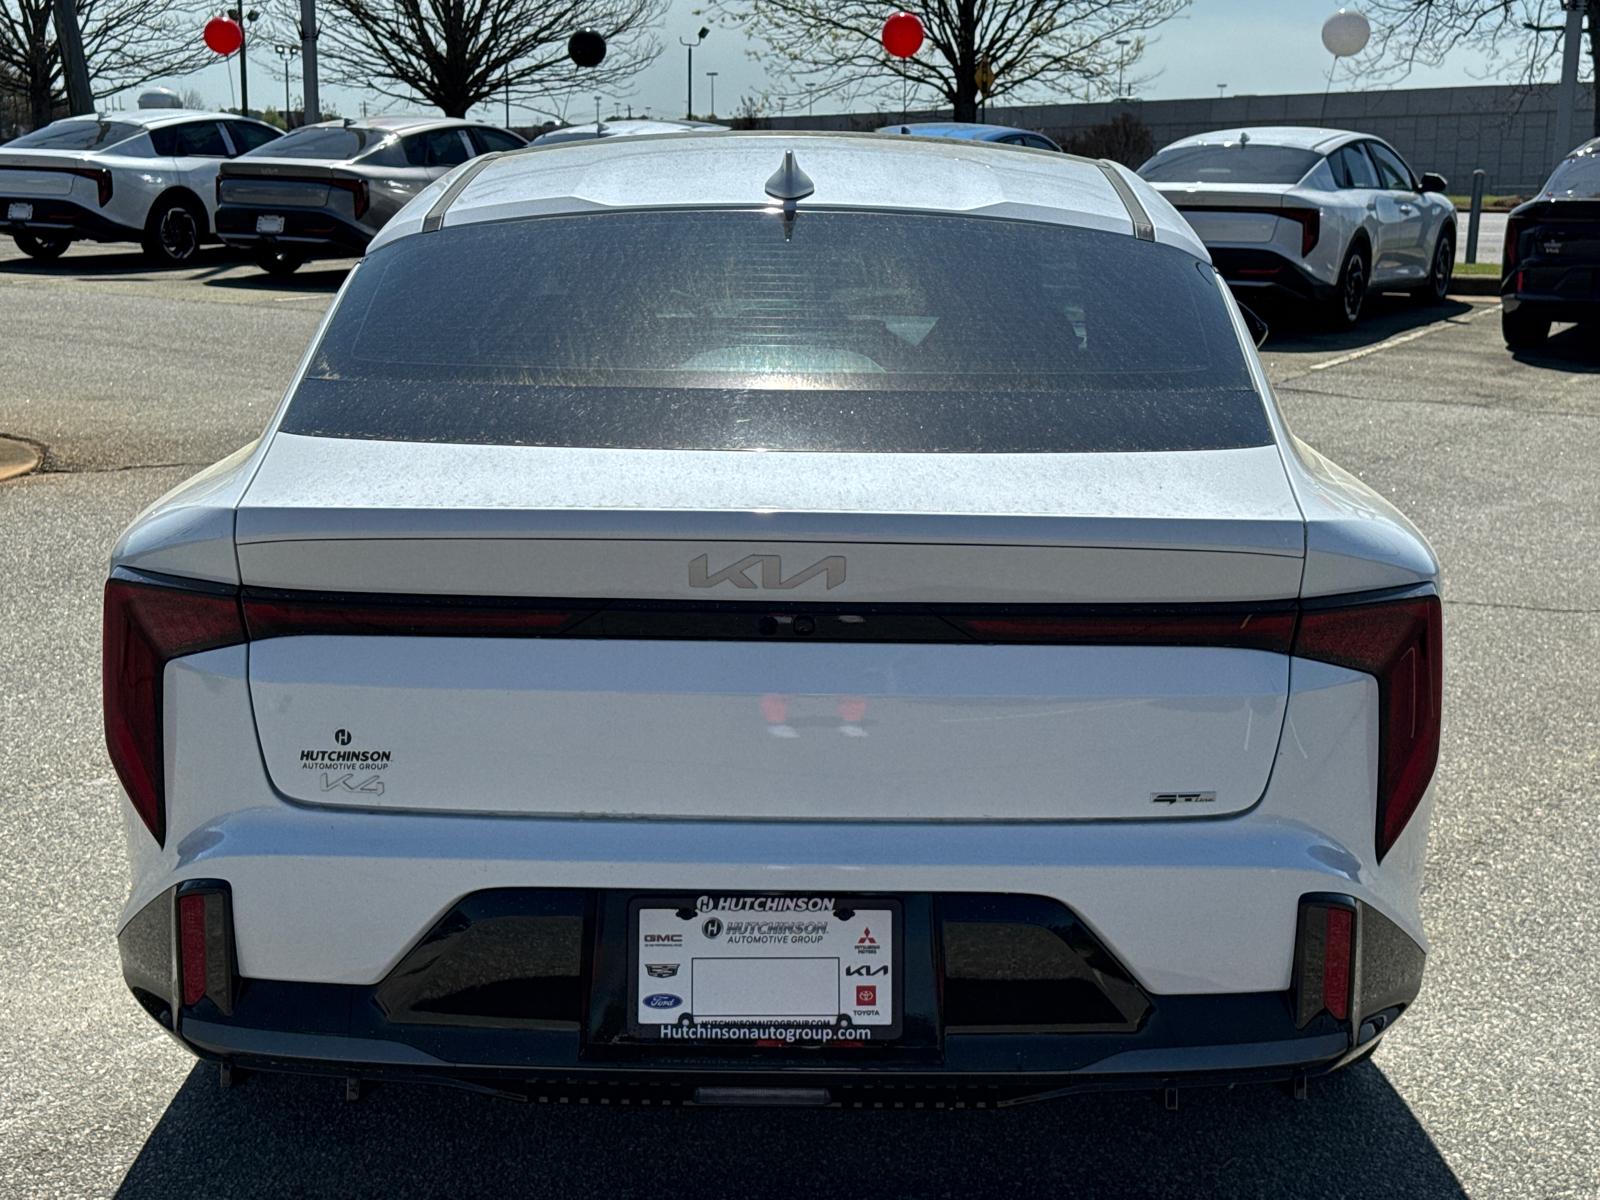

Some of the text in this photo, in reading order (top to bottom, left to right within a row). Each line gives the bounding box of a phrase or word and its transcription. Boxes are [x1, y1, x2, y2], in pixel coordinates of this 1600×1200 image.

[689, 553, 846, 591] KIA
[300, 750, 391, 762] HUTCHINSON
[302, 762, 356, 770] AUTOMOTIVE
[320, 772, 385, 796] K4
[718, 897, 835, 912] HUTCHINSON
[726, 921, 828, 935] HUTCHINSON
[644, 934, 683, 942] GMC
[727, 935, 823, 944] AUTOMOTIVE GROUP
[845, 965, 889, 976] KIA
[650, 995, 675, 1006] Ford
[660, 1023, 871, 1042] Hutchinsonautogroup.com
